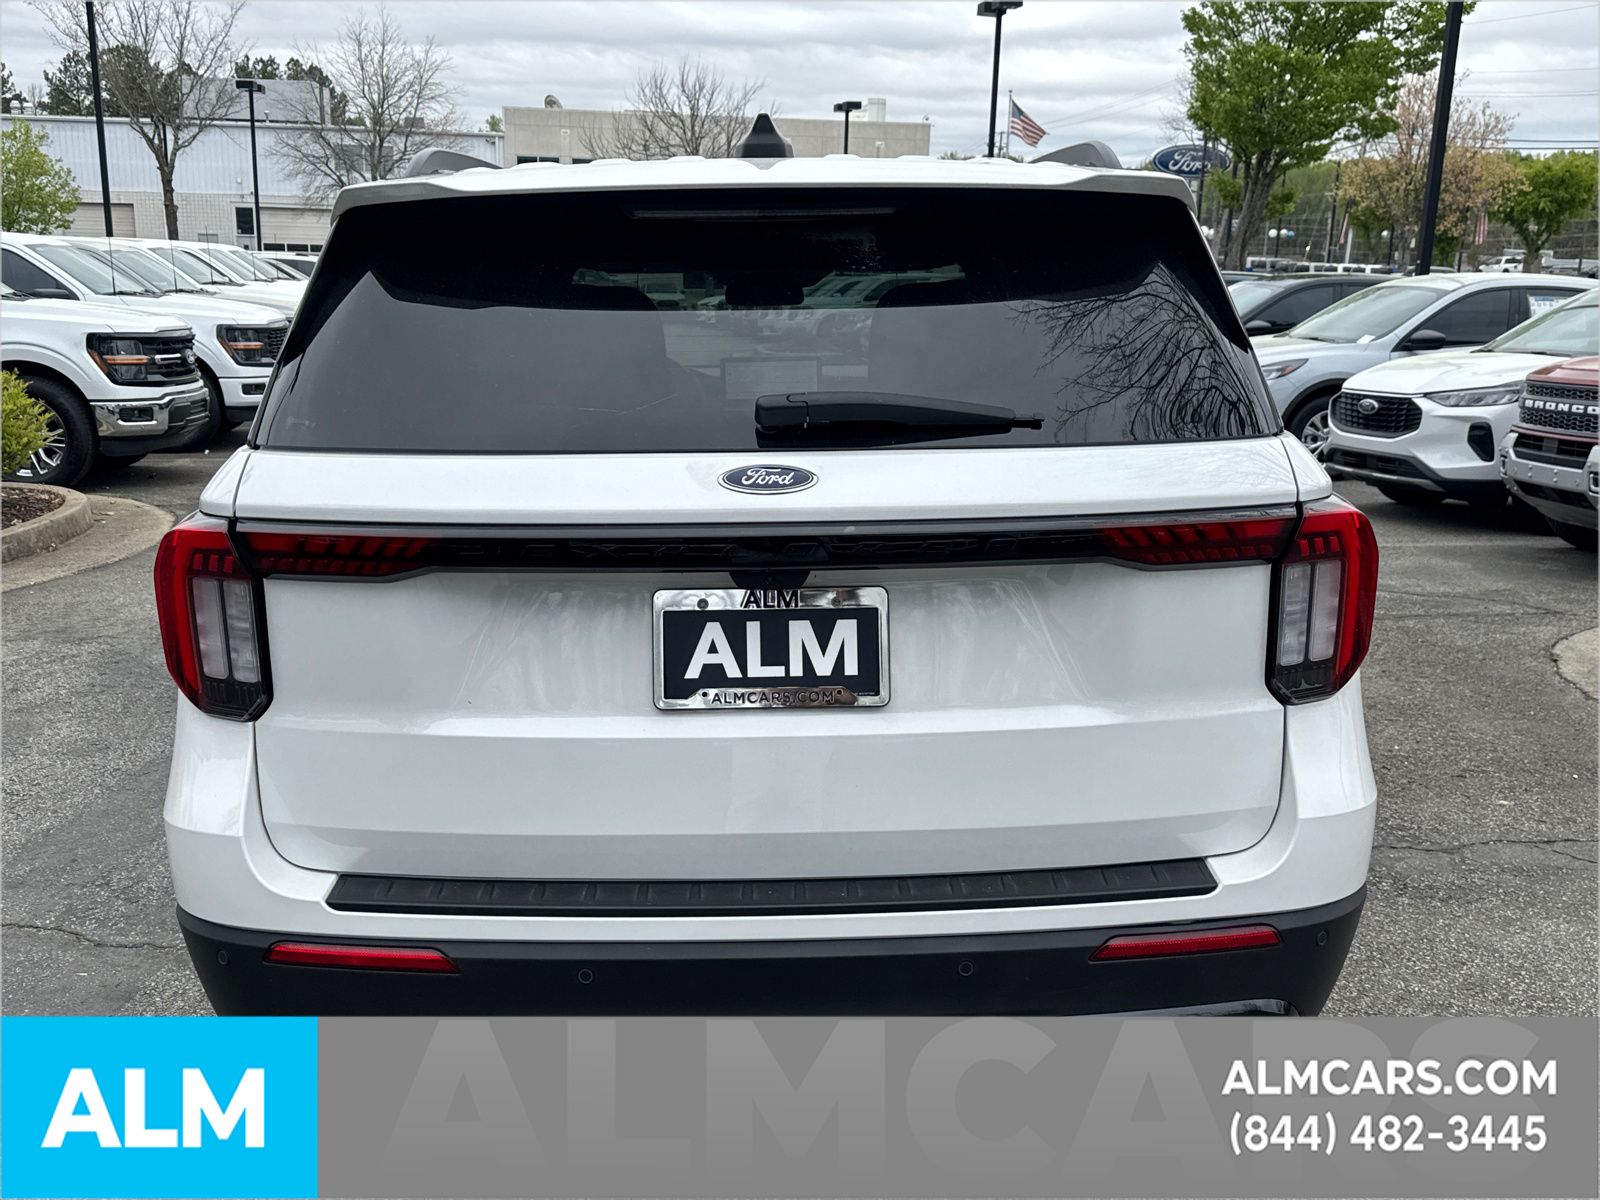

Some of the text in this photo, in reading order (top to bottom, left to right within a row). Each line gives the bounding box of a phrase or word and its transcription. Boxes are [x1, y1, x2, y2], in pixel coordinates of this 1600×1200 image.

[1524, 399, 1599, 414] BRONCO
[741, 468, 795, 485] Ford
[739, 590, 800, 609] ALM
[683, 618, 859, 679] ALM
[710, 690, 835, 705] ALMCARS.COM
